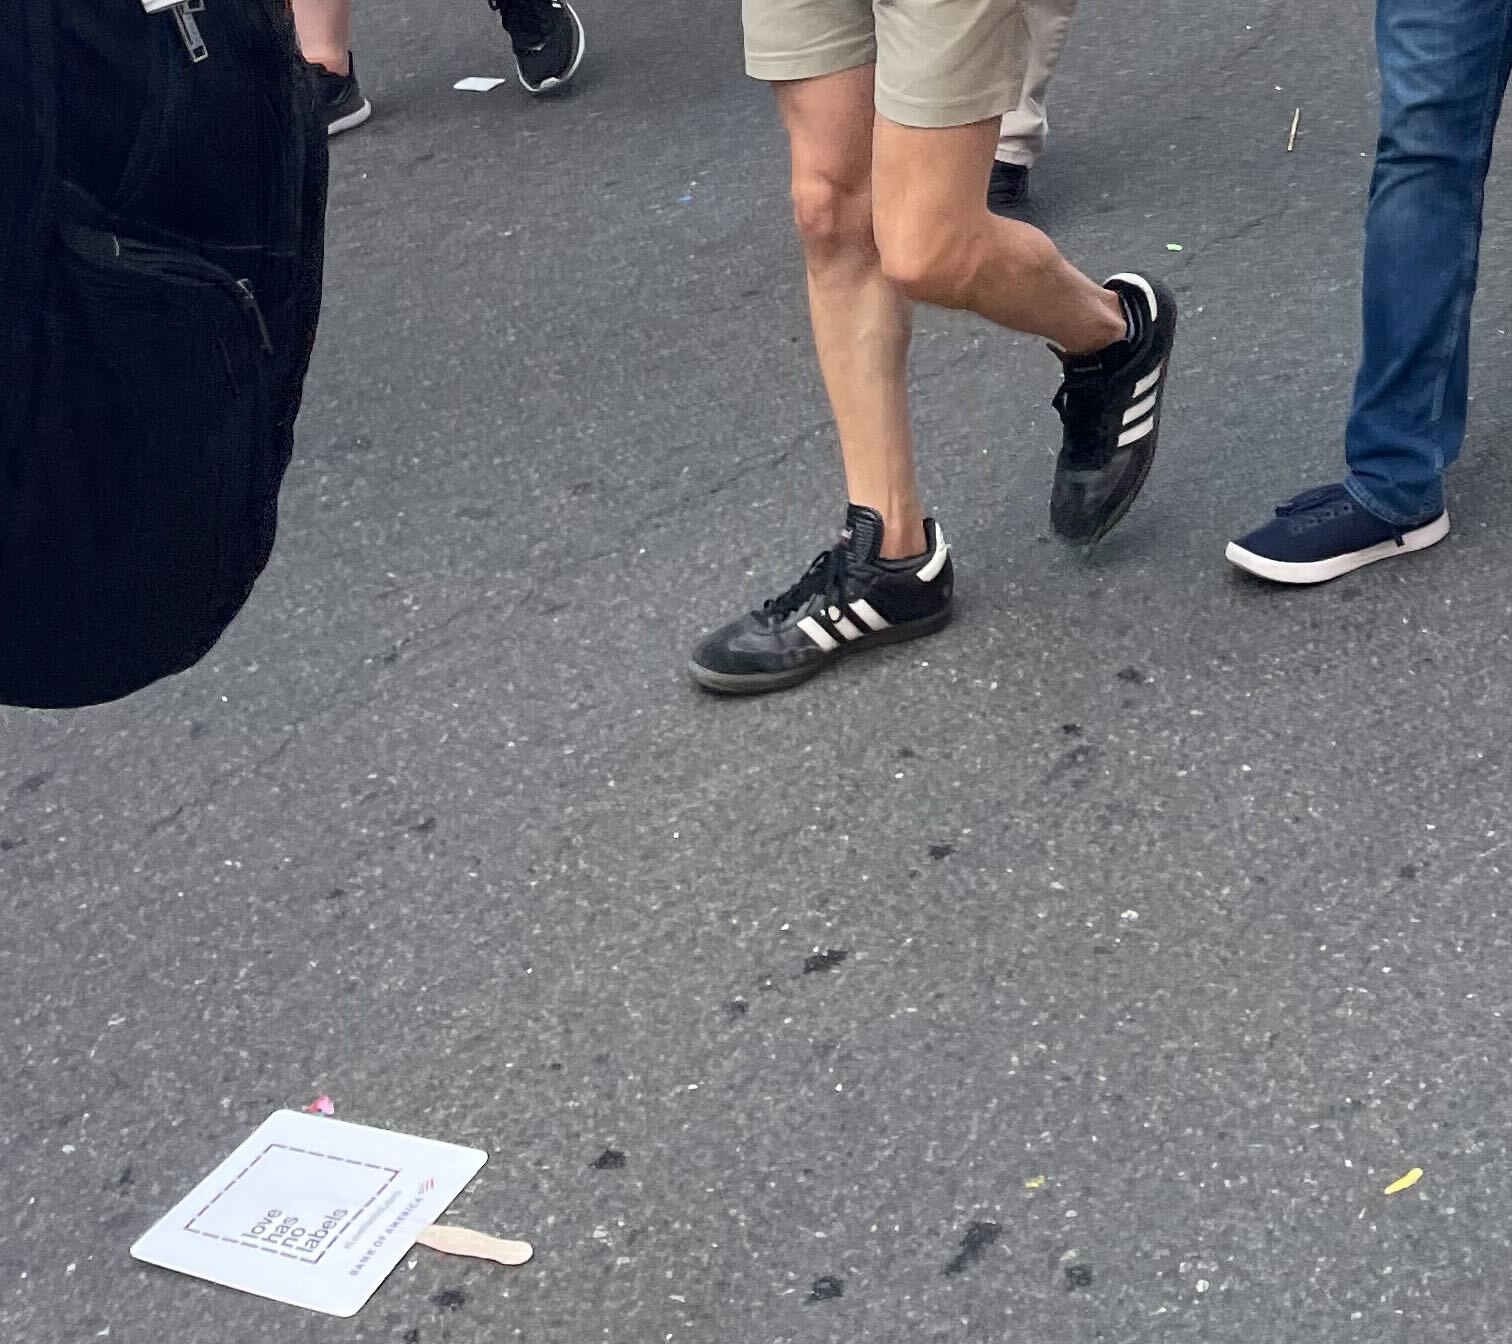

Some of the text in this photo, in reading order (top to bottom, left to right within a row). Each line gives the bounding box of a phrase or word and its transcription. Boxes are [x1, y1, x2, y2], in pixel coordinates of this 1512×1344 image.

[240, 1208, 282, 1239] love
[260, 1216, 299, 1244] has
[280, 1227, 306, 1248] no
[295, 1209, 348, 1253] labels
